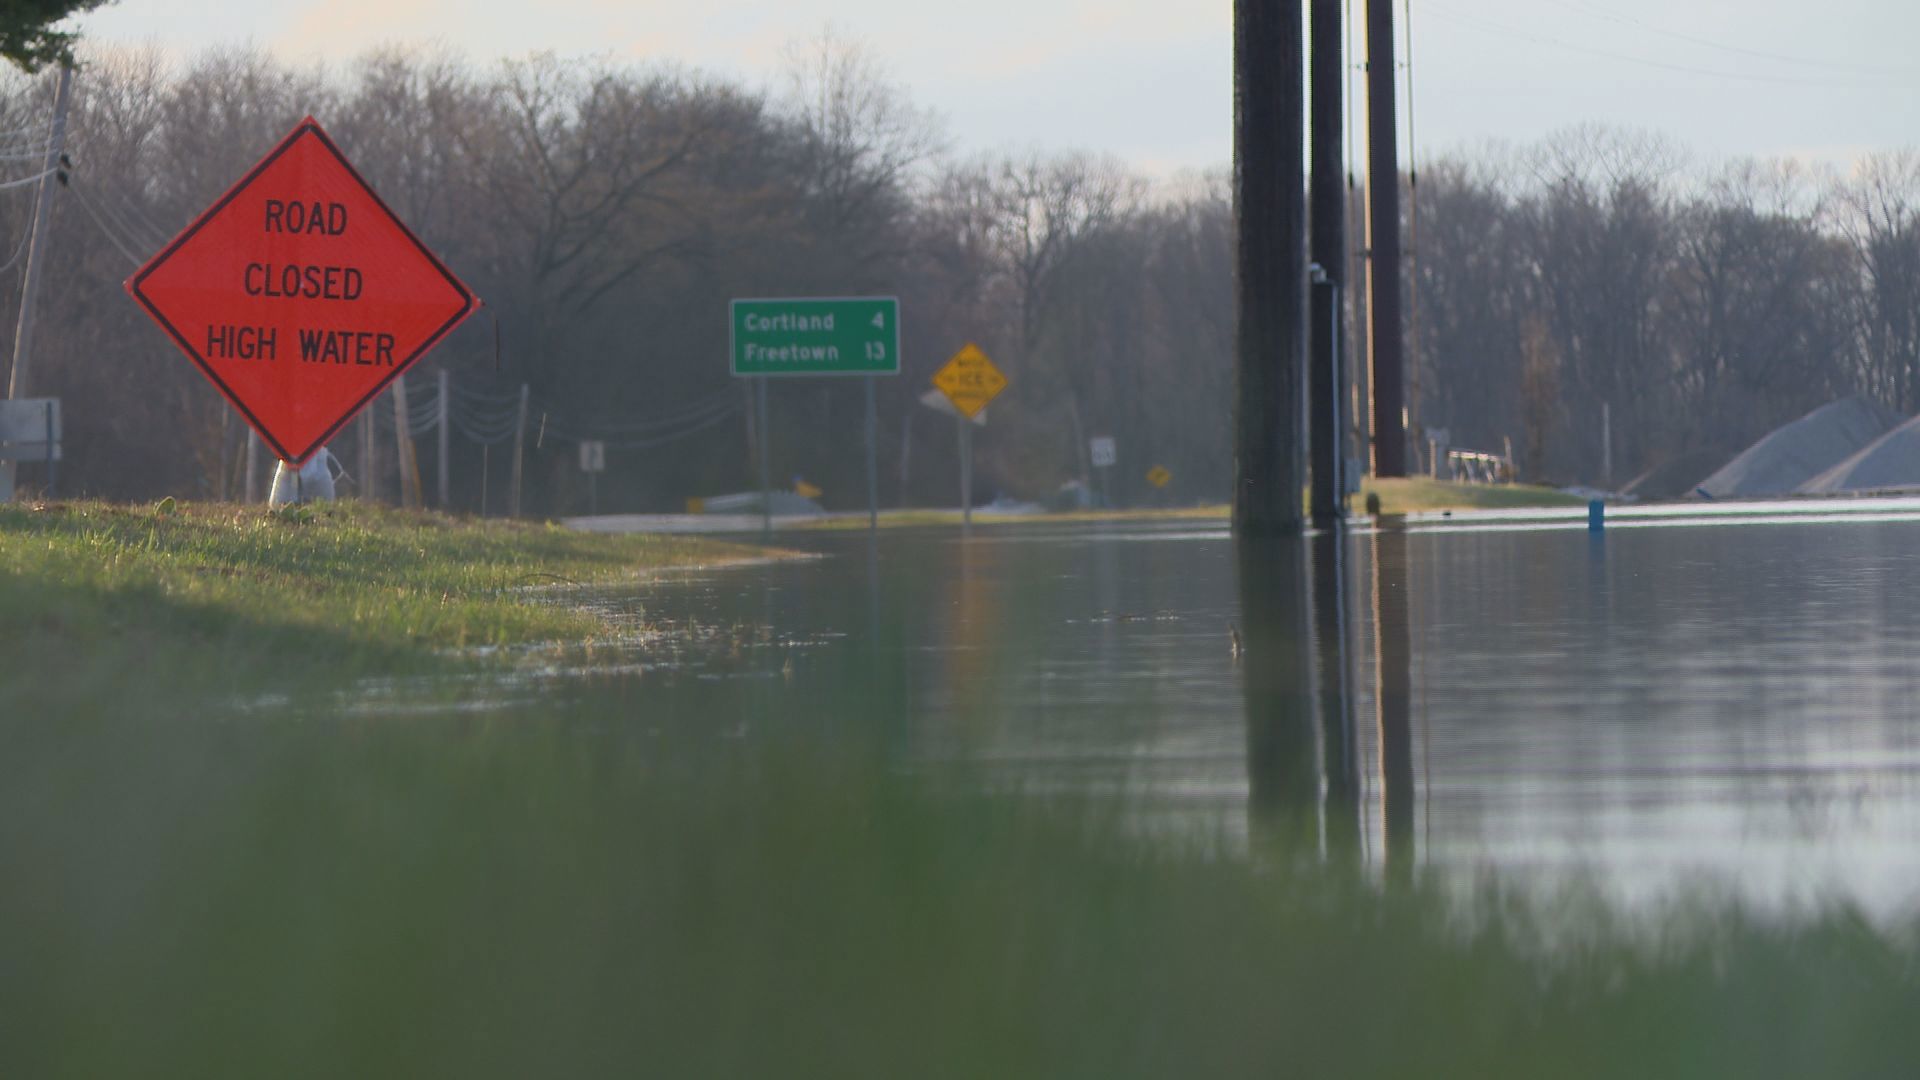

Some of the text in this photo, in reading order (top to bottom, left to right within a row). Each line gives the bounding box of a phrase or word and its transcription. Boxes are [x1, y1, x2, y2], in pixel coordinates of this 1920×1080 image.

[264, 199, 348, 236] ROAD
[244, 263, 363, 301] CLOSED
[744, 311, 884, 331] Cortland 4
[206, 325, 396, 367] HIGH WATER
[743, 341, 886, 361] Freetown 13
